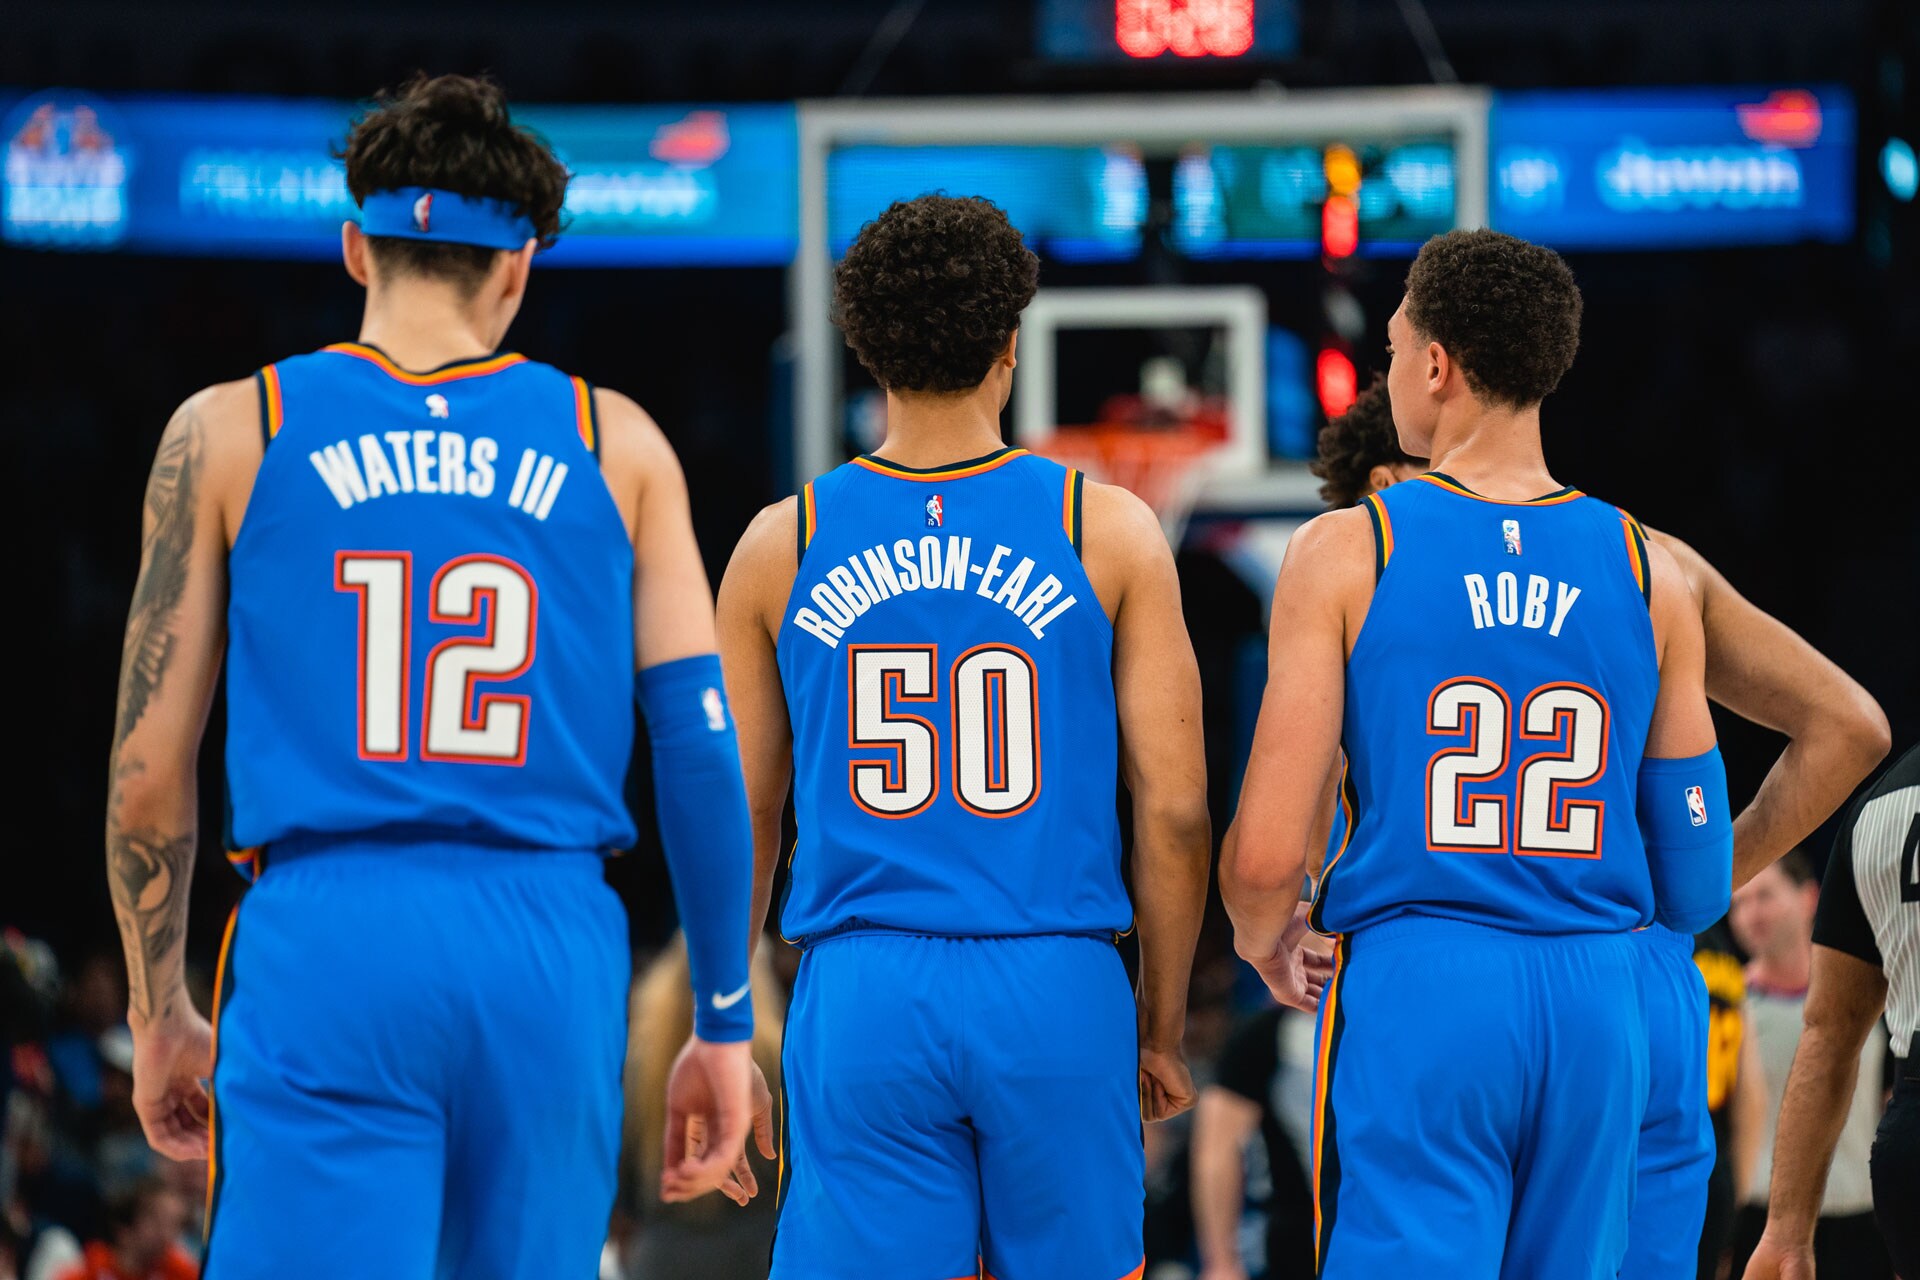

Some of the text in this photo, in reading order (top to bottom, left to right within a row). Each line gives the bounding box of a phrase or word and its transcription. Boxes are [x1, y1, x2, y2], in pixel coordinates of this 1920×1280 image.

[309, 431, 569, 521] WATERS III
[334, 550, 539, 767] 12
[793, 535, 1078, 649] ROBINSON-EARL
[1464, 571, 1582, 637] ROBY
[848, 642, 1042, 820] 50
[1425, 675, 1611, 860] 22
